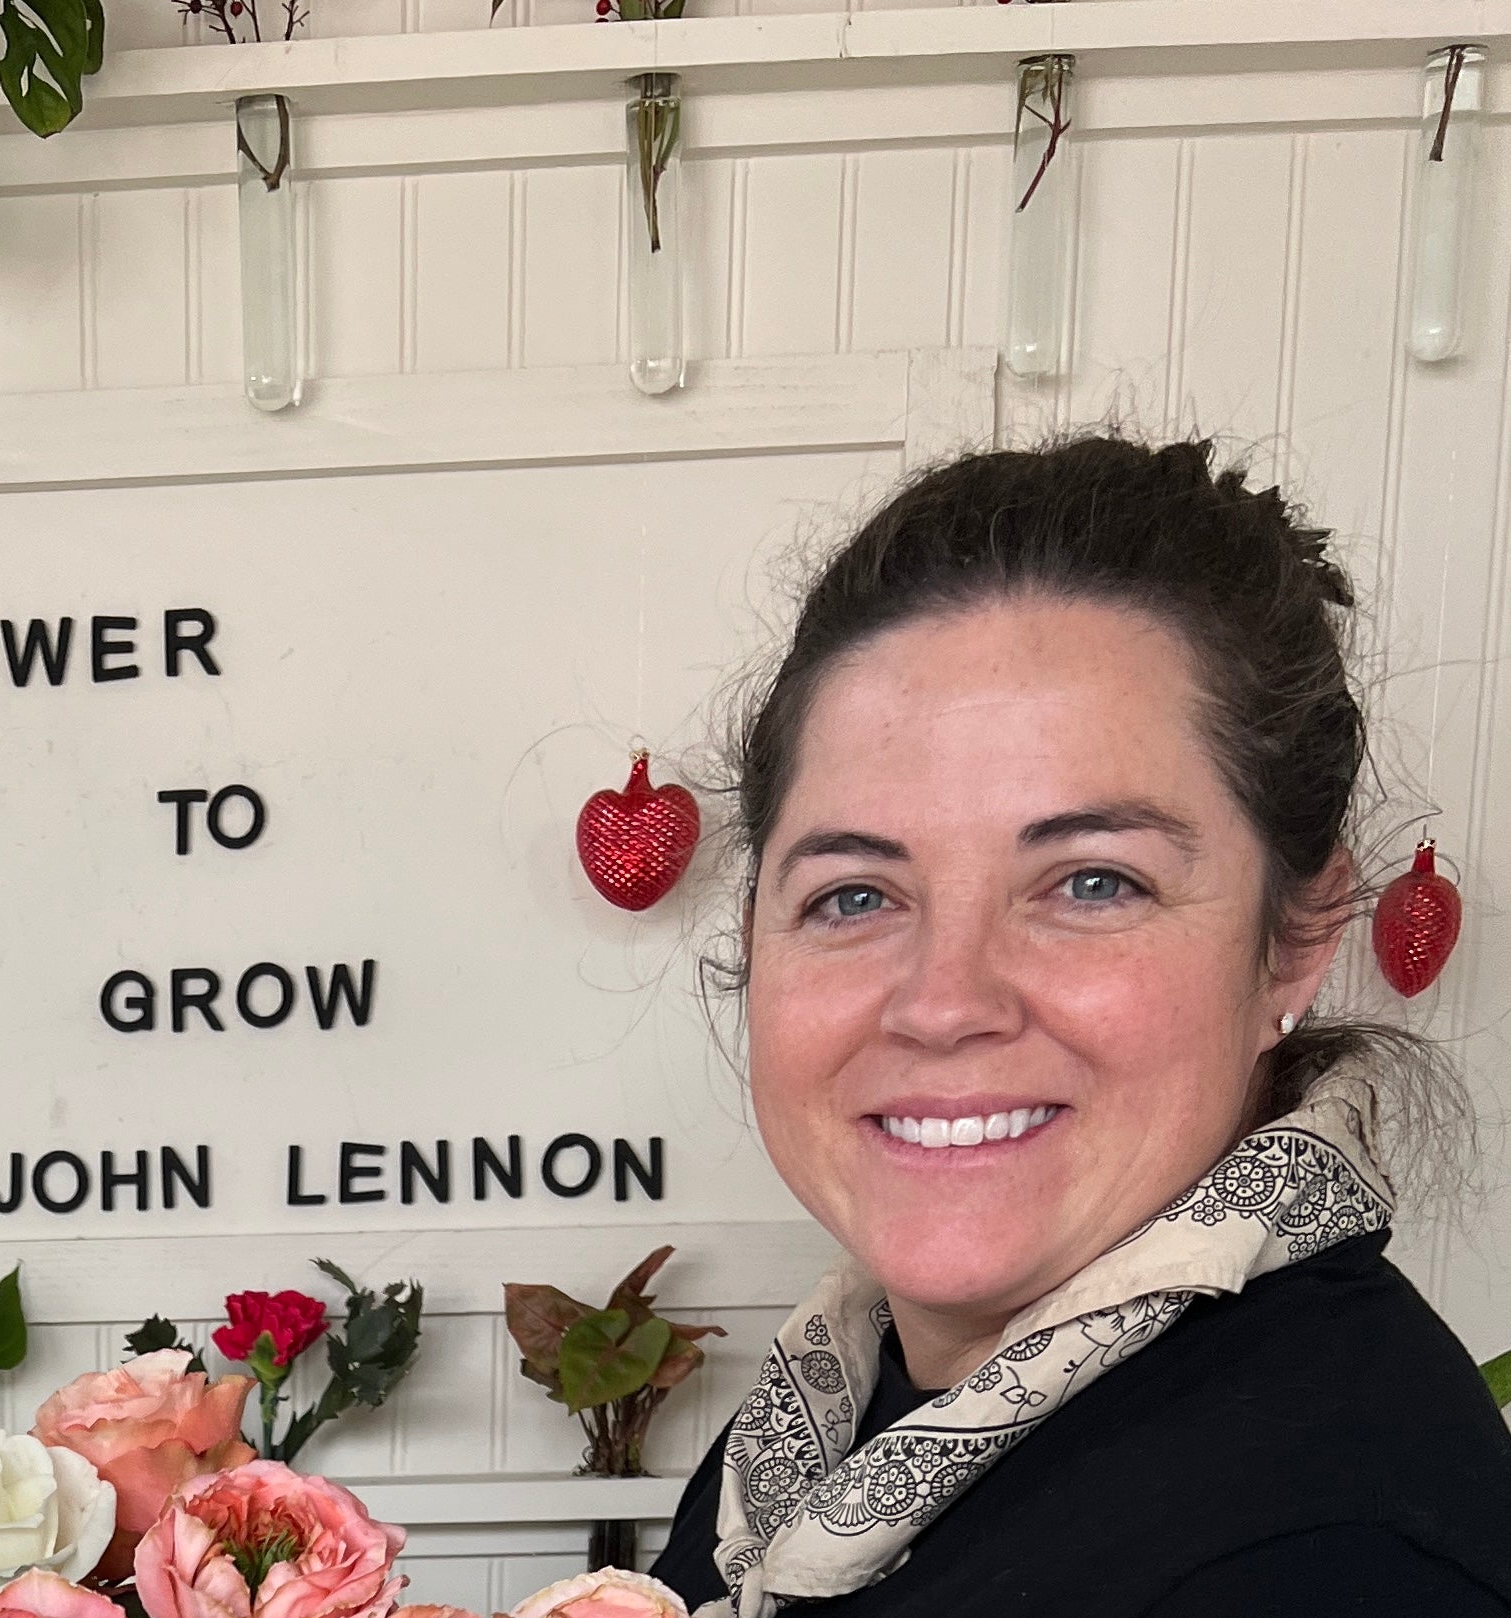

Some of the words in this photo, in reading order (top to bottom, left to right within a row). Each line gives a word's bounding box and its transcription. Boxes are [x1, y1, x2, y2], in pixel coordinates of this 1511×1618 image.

[156, 784, 267, 856] TO
[99, 958, 377, 1034] GROW
[285, 1132, 666, 1207] LENNON
